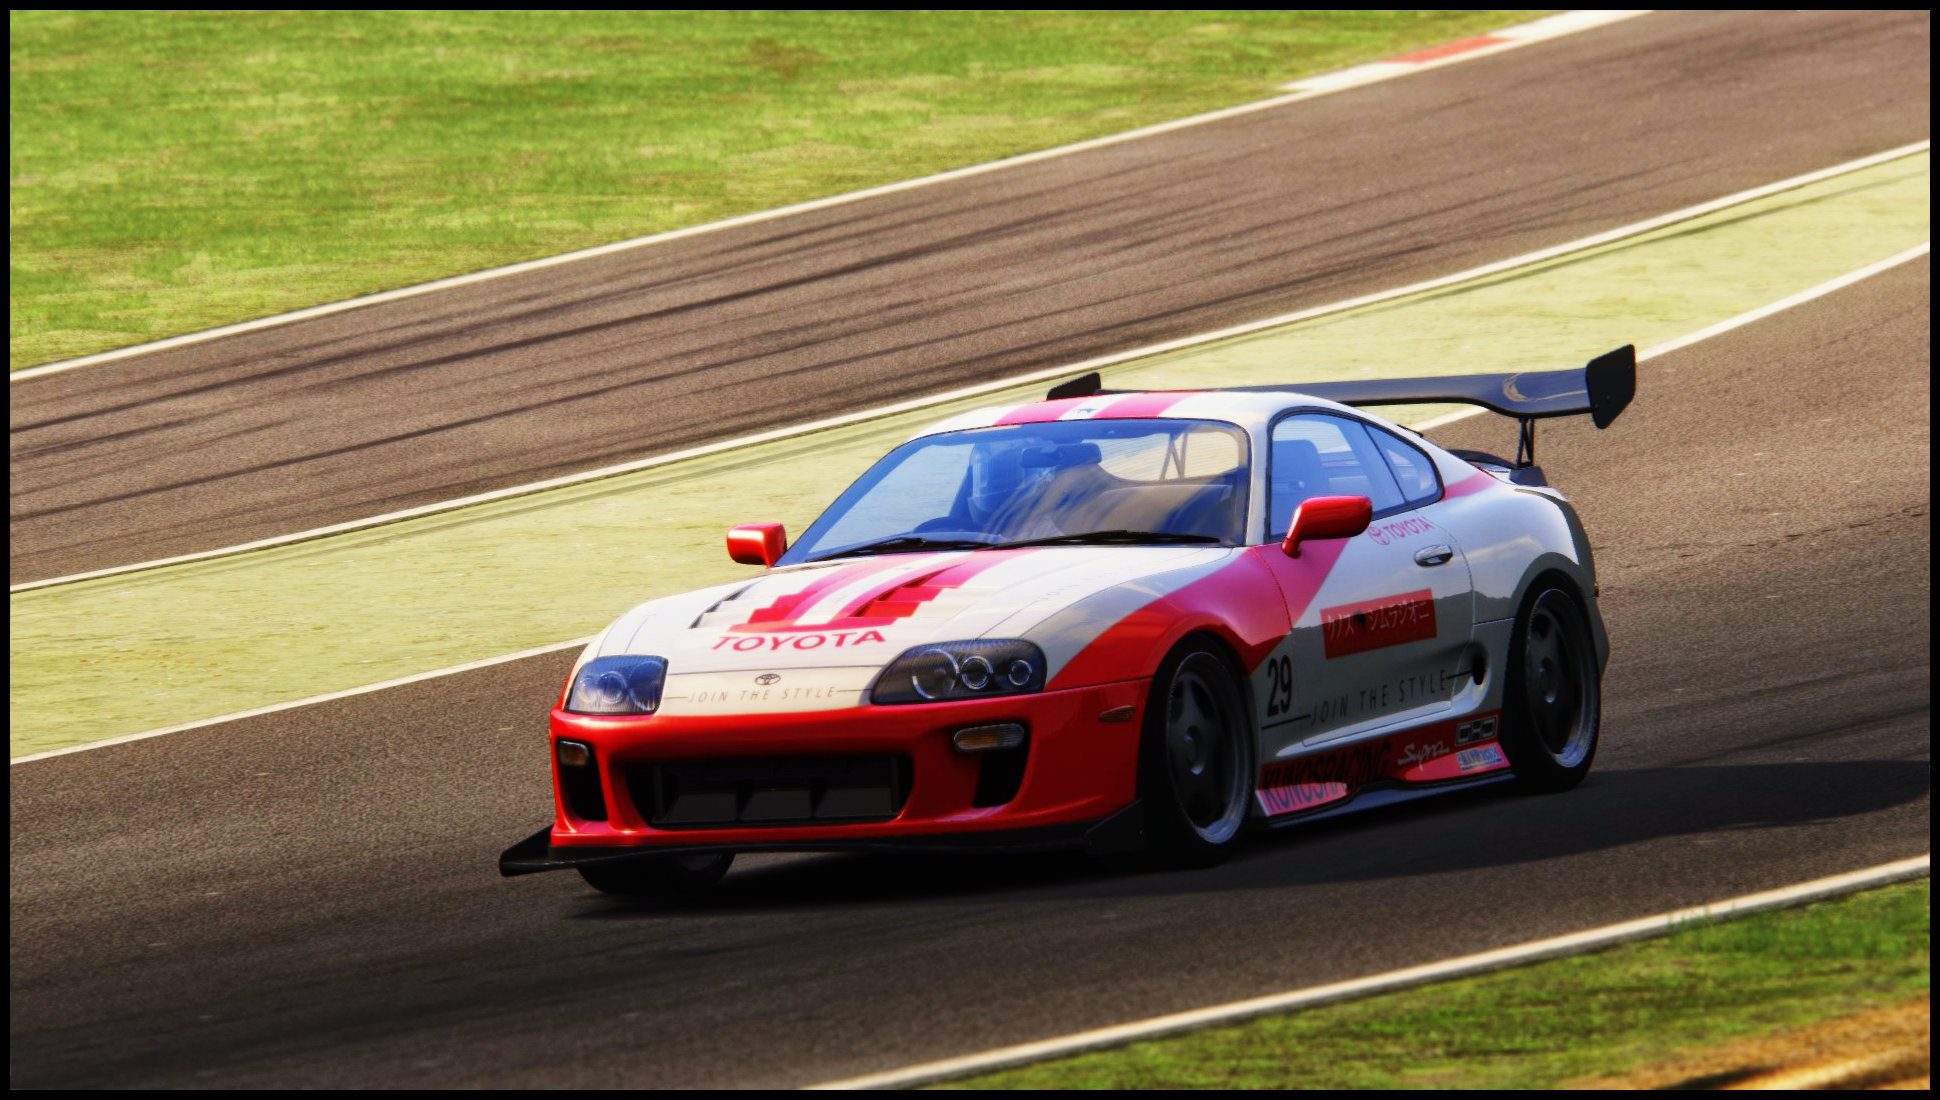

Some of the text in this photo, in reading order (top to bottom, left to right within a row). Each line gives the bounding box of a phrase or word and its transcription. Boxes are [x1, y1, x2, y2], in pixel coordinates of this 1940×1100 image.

[1383, 517, 1433, 540] TOYOTA
[712, 630, 886, 651] TOYOTA
[688, 687, 836, 703] JOIN THE STYLE
[1267, 655, 1292, 716] 29
[1312, 670, 1445, 724] JOIN THE STYLE
[1397, 741, 1449, 771] Supra
